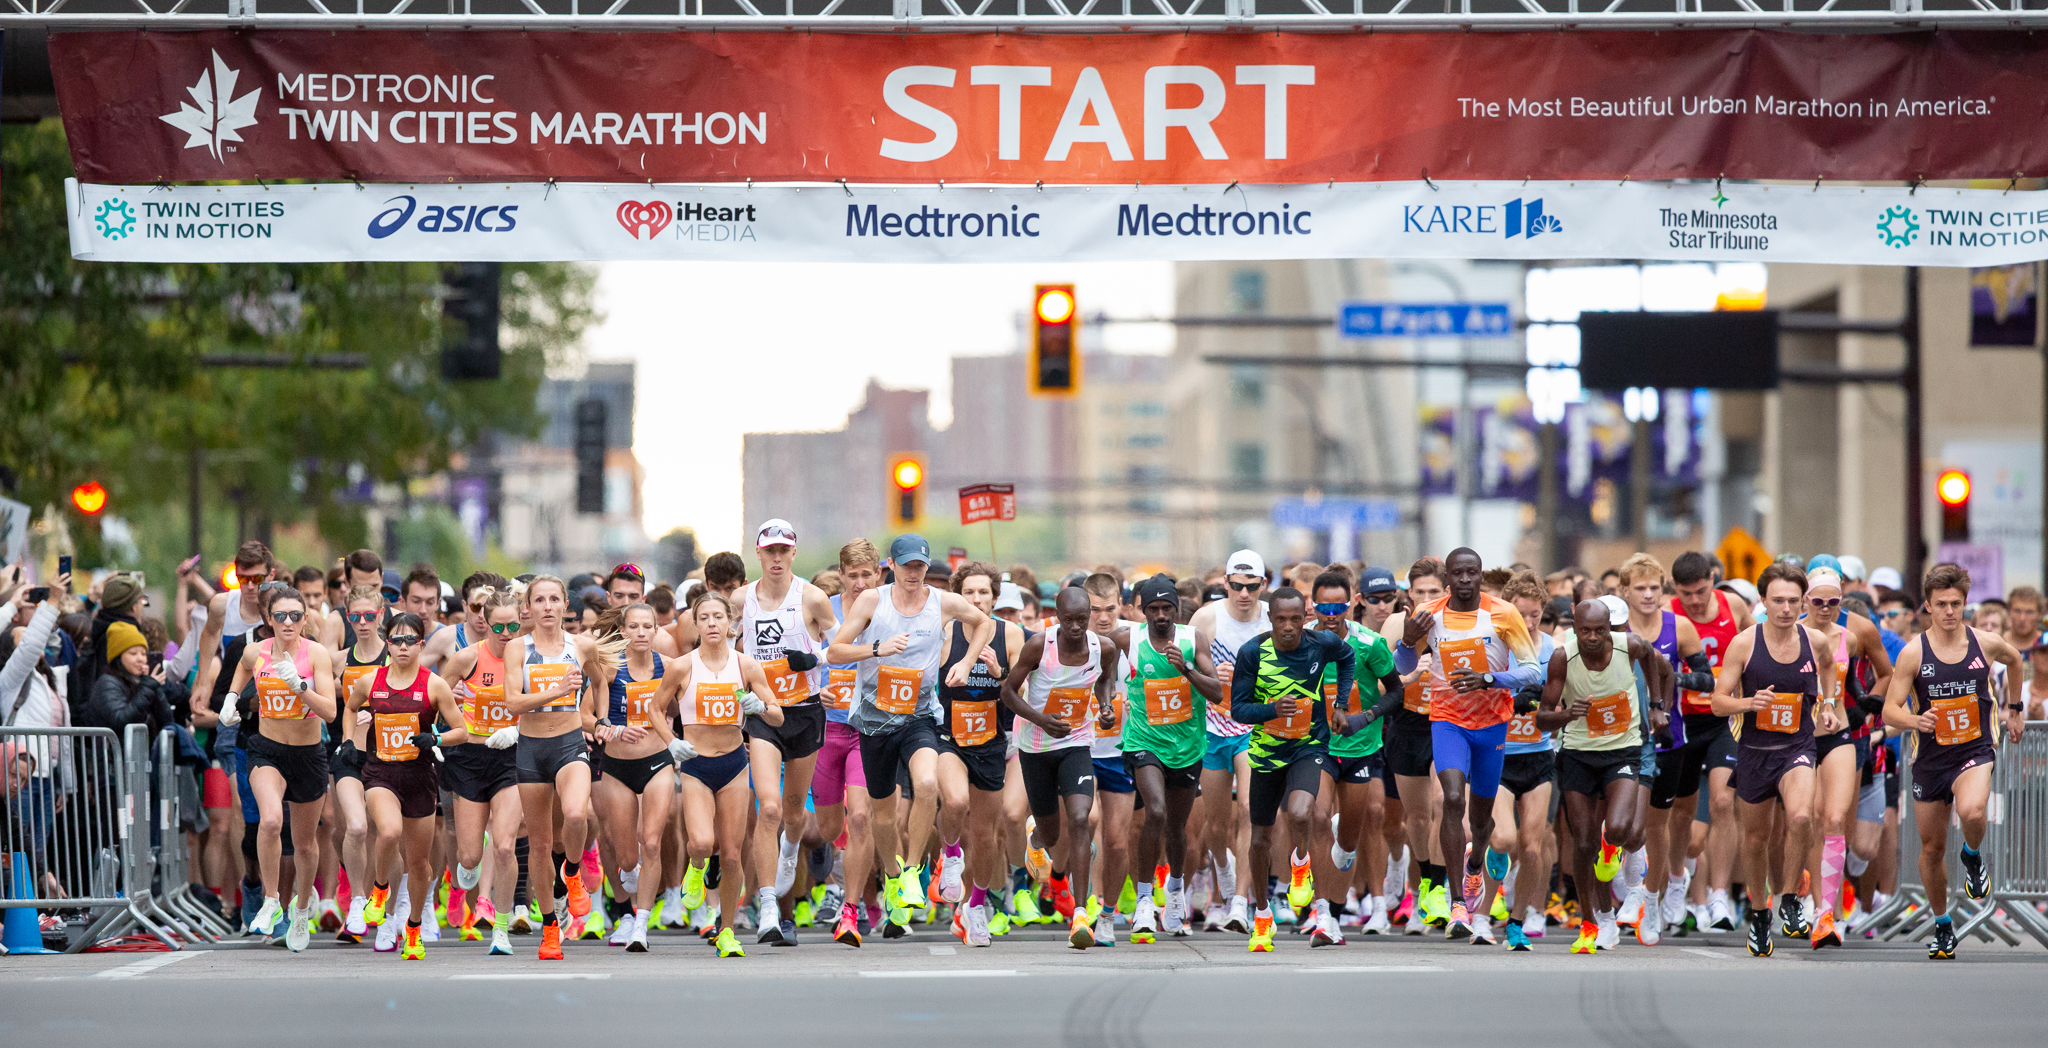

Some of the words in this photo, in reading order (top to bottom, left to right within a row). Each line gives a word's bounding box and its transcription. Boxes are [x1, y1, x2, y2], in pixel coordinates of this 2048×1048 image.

[277, 73, 495, 104] MEDTRONIC
[879, 65, 1315, 162] START
[1457, 97, 1501, 117] The
[1508, 97, 1563, 117] Most
[1570, 96, 1674, 117] Beautiful
[1681, 95, 1747, 115] Urban
[1755, 95, 1862, 118] Marathon
[1869, 98, 1888, 118] in
[278, 107, 379, 143] TWIN
[389, 111, 518, 144] CITIES
[530, 111, 767, 145] MARATHON
[142, 202, 204, 217] TWIN
[207, 201, 285, 218] CITIES
[676, 202, 756, 222] iHeart
[1926, 209, 1982, 227] TWIN
[1989, 209, 2048, 227] CITIE
[846, 204, 1039, 238] Medtronic
[1117, 203, 1311, 237] Medtronic
[1402, 204, 1498, 233] KARE
[1659, 208, 1688, 228] The
[1691, 209, 1777, 230] Minnesota
[147, 223, 169, 239] IN
[176, 222, 272, 239] MOTION
[676, 224, 757, 242] MEDIA
[1929, 230, 1952, 246] IN
[1669, 229, 1706, 248] Star
[1707, 230, 1769, 250] Tribune
[774, 672, 799, 693] 27
[890, 678, 912, 686] NORRIS
[1928, 679, 1977, 690] GAZELLE
[1928, 684, 1977, 697] ELITE
[890, 684, 913, 701] 10
[264, 695, 297, 711] 107
[702, 701, 735, 718] 103
[1060, 704, 1074, 717] 3
[1159, 695, 1182, 711] 16
[965, 717, 987, 733] 12
[1602, 711, 1616, 724] 8
[1771, 710, 1793, 726] 18
[1947, 713, 1970, 731] 15
[1509, 719, 1535, 736] 26
[381, 731, 415, 748] 104
